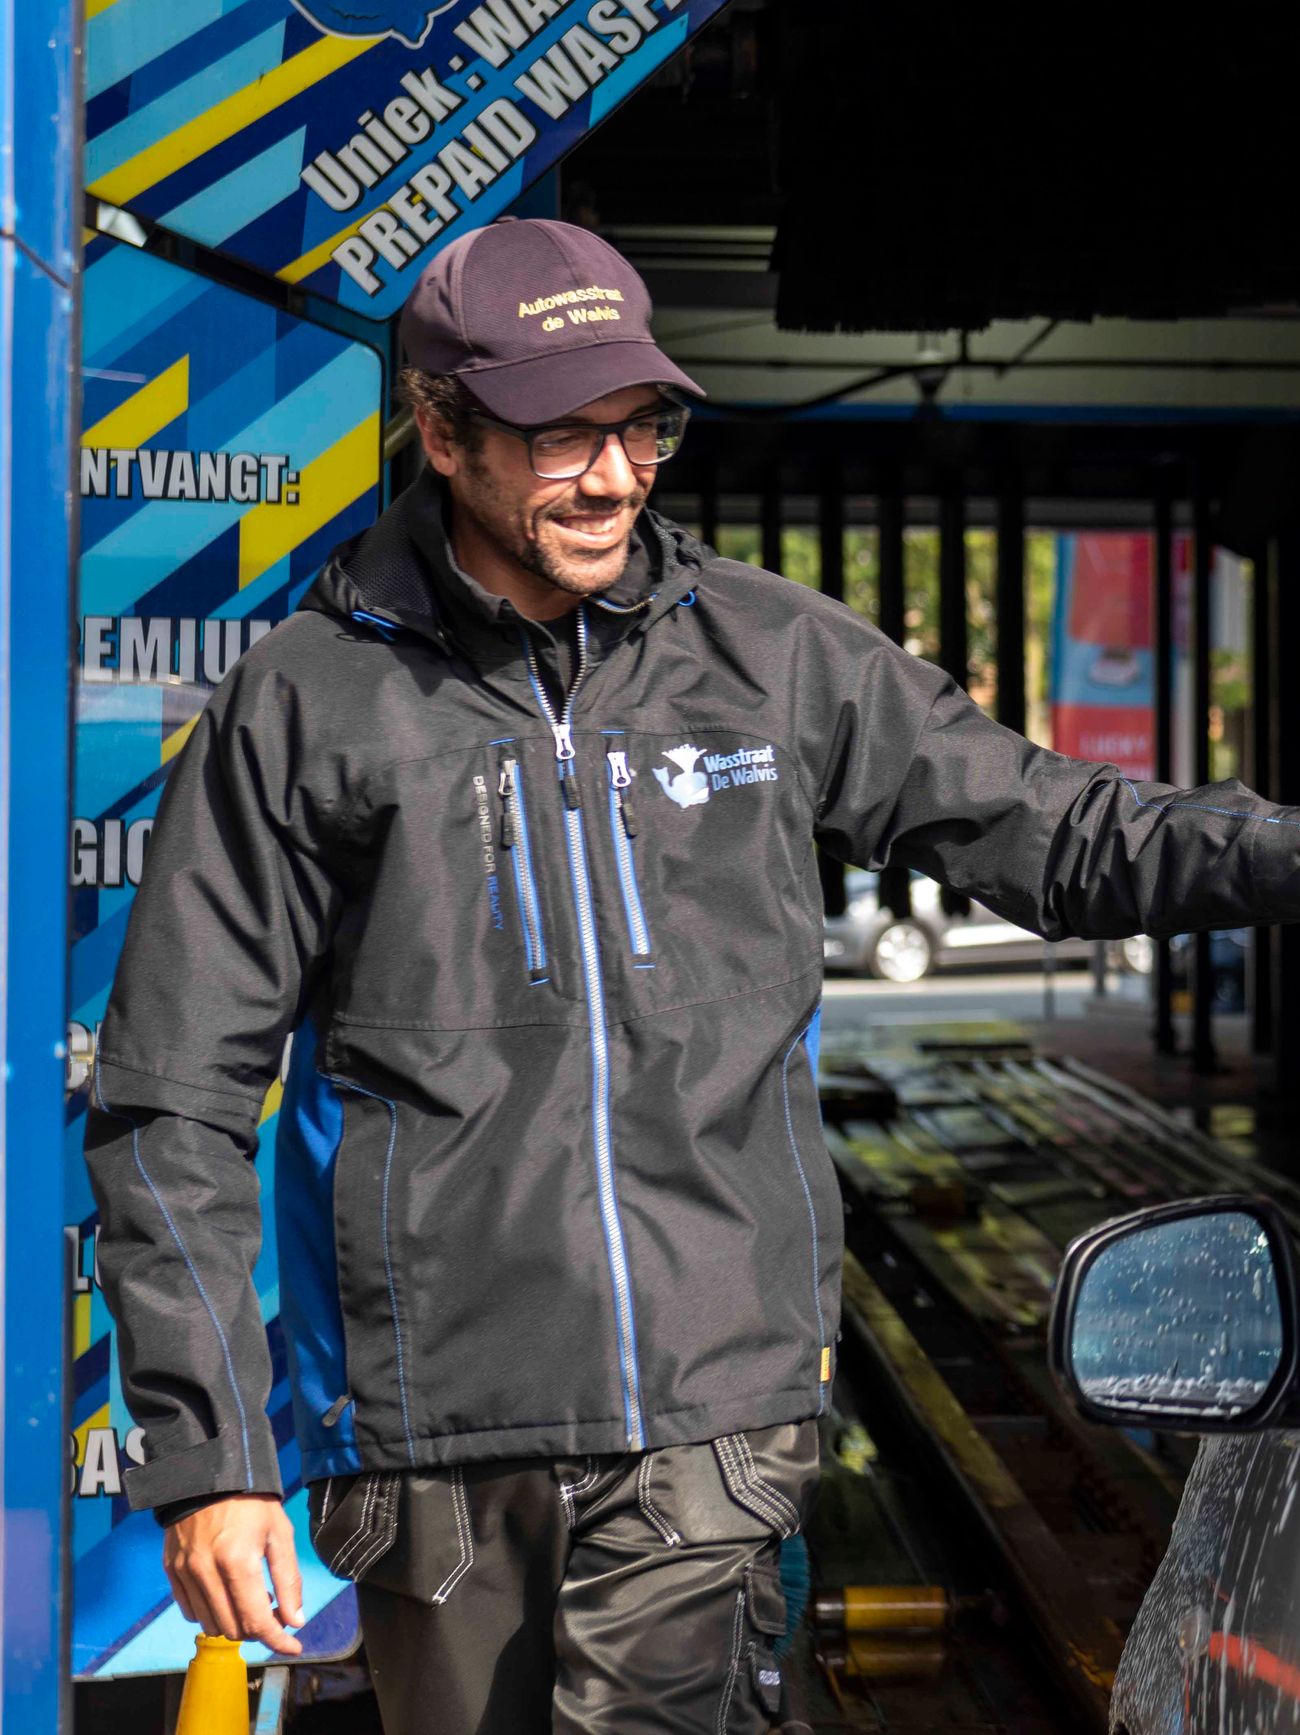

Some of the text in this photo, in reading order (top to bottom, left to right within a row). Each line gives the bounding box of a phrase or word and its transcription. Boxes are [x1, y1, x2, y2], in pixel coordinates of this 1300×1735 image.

[300, 67, 462, 211] Uniek
[330, 98, 536, 295] PREPAID
[542, 305, 620, 331] de Walvis
[80, 447, 299, 502] NTVANGT:
[83, 616, 272, 684] EMIU
[703, 745, 775, 773] Wasstraat
[711, 764, 778, 791] De Walvis
[473, 776, 492, 842] DESIGNED
[483, 845, 496, 873] FOR
